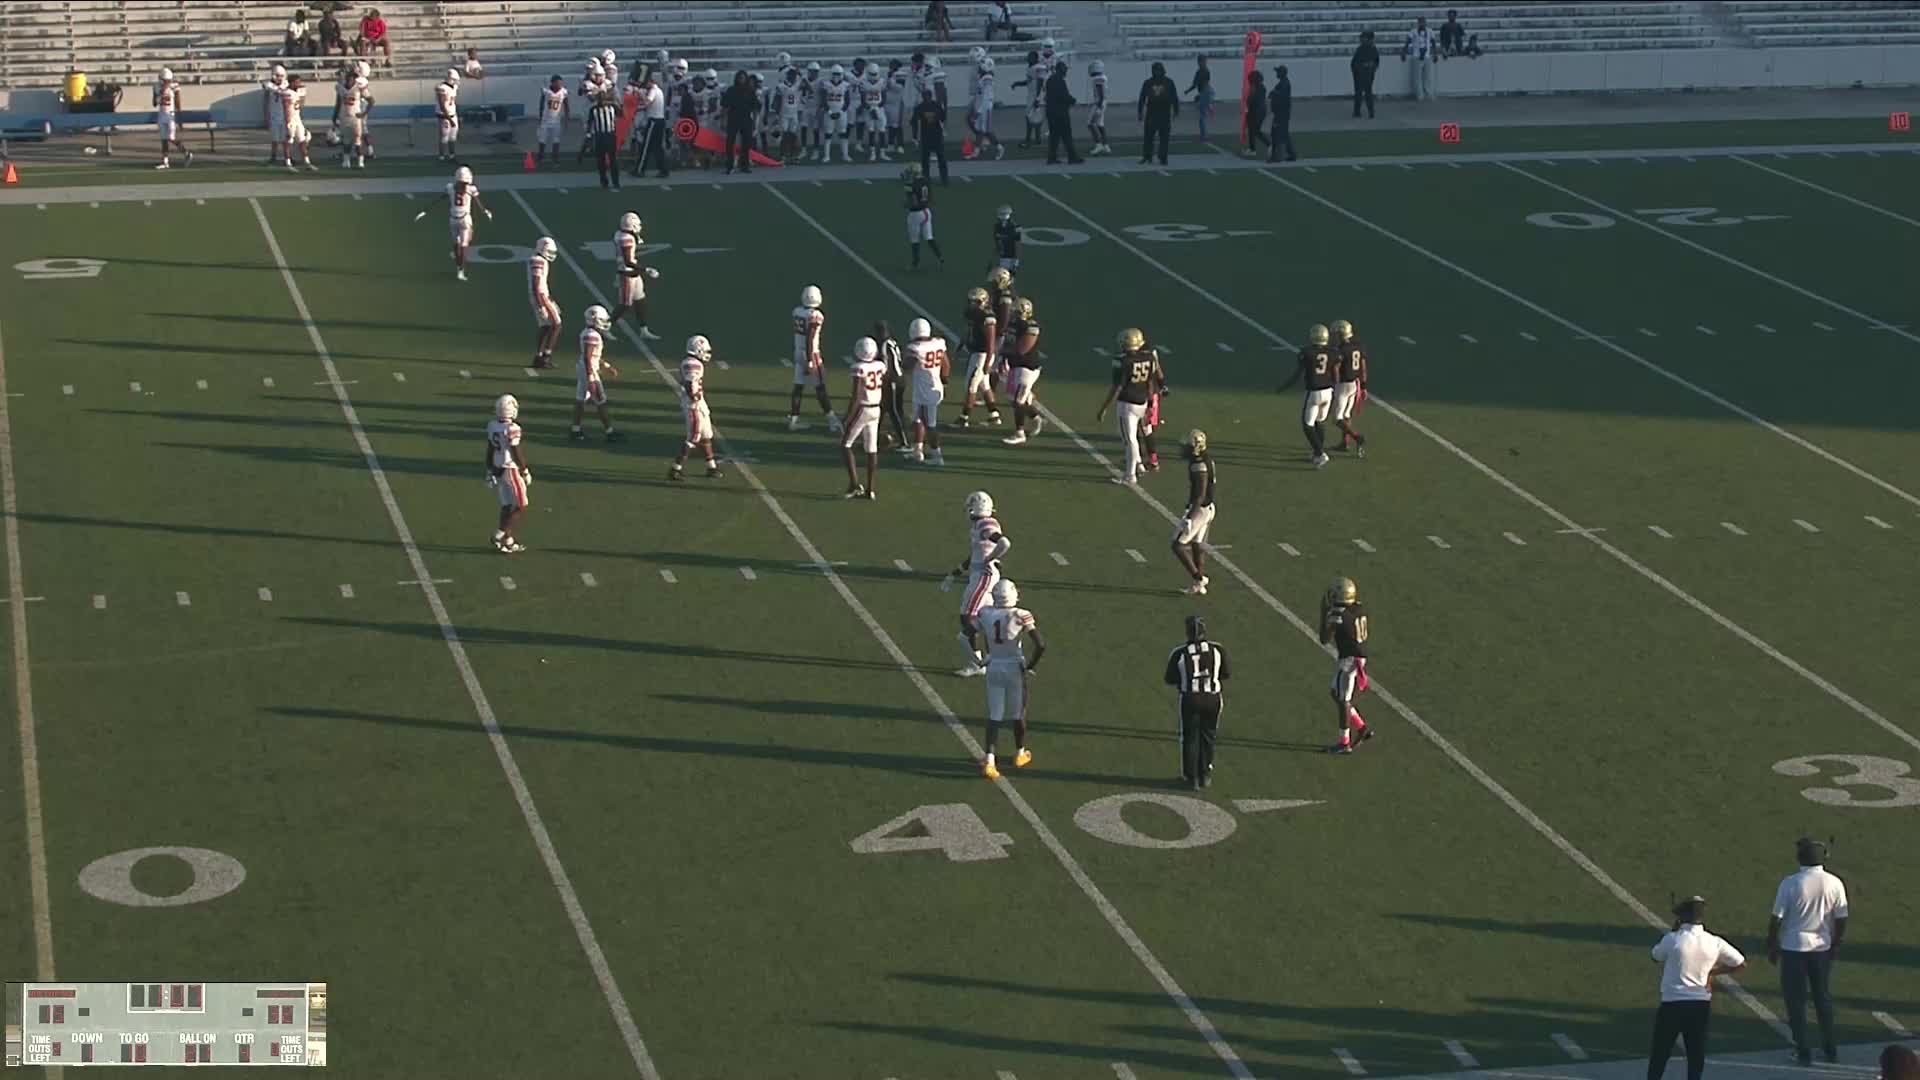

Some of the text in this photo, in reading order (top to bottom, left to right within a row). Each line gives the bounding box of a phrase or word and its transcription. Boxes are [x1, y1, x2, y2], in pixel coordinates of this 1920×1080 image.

[1442, 124, 1457, 140] 20
[1893, 114, 1907, 129] 10
[1314, 353, 1329, 374] 3
[1351, 350, 1362, 371] 8
[864, 369, 883, 391] 33
[1131, 361, 1150, 384] 55
[993, 619, 1003, 644] 1
[1354, 615, 1368, 644] 10
[1191, 654, 1209, 678] L
